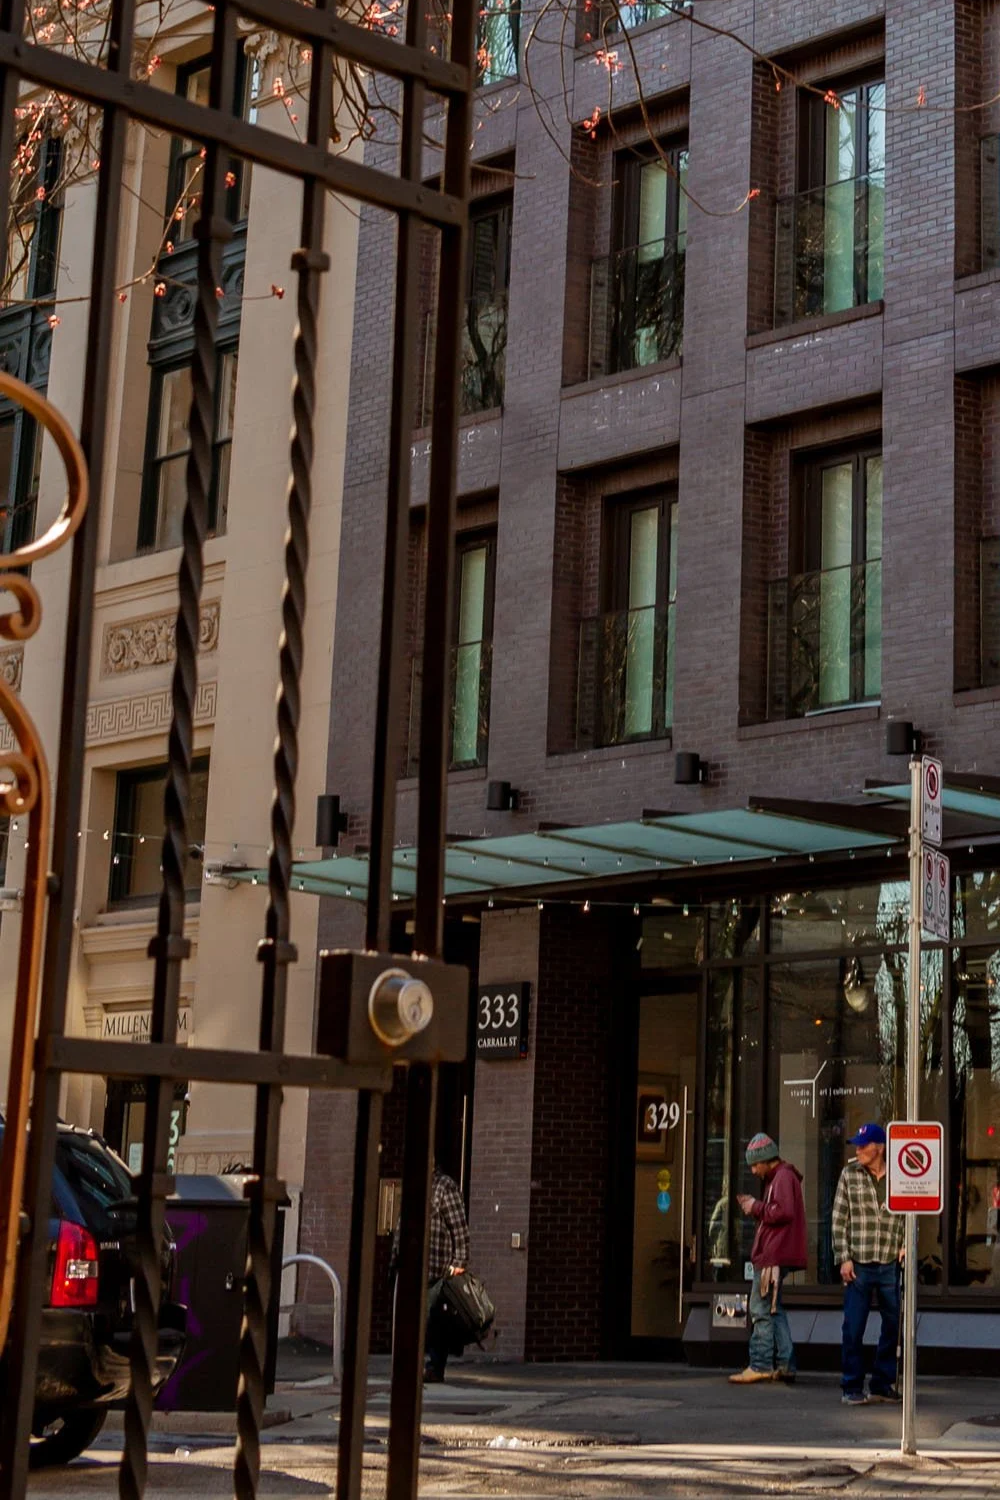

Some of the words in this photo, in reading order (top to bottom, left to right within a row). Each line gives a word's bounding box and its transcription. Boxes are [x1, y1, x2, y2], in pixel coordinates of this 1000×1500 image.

[104, 1011, 188, 1037] MILLENM
[478, 993, 519, 1029] 333
[477, 1036, 508, 1048] CARRALL
[508, 1035, 518, 1047] ST
[819, 1087, 828, 1096] art
[647, 1101, 680, 1130] 329
